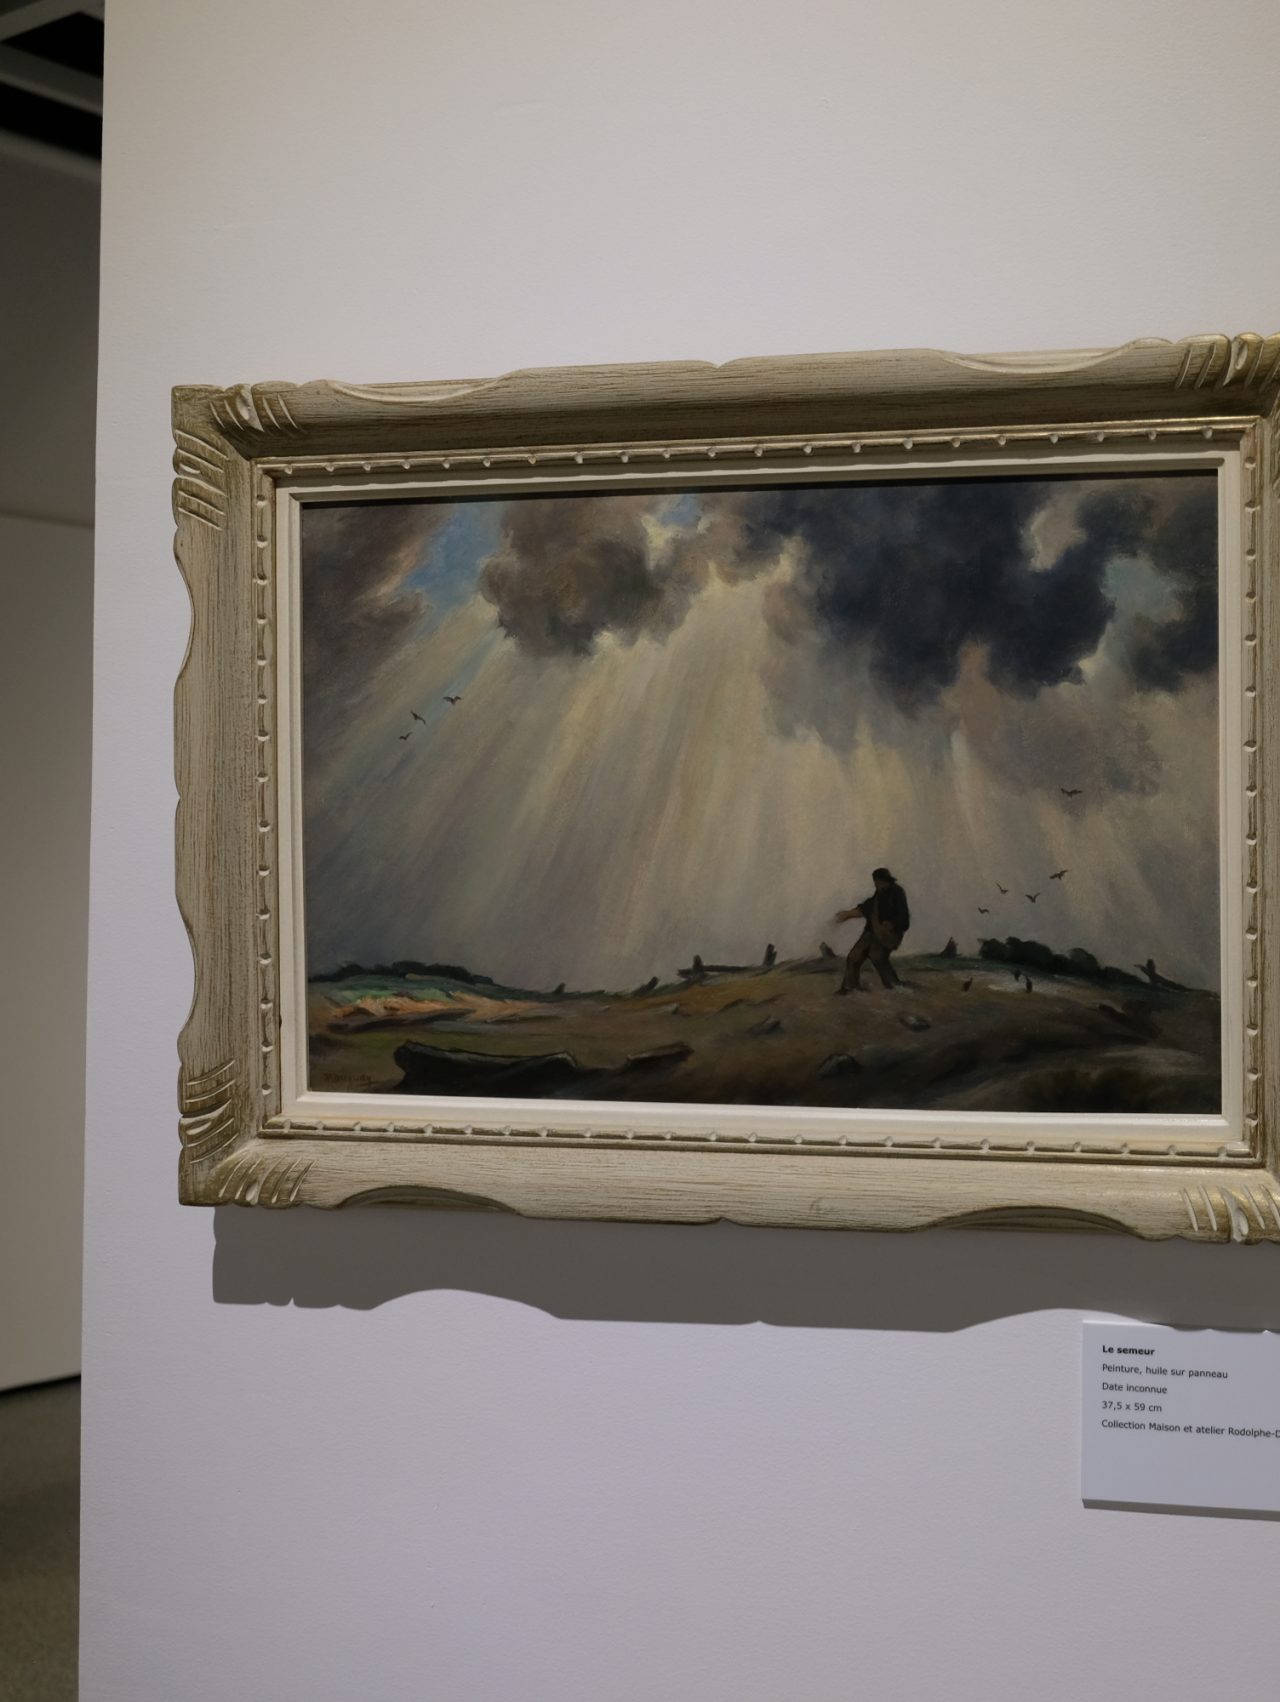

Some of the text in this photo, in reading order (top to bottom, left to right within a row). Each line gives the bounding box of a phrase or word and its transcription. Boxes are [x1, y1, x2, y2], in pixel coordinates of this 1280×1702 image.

[1102, 1344, 1156, 1357] Le semeur
[1102, 1362, 1229, 1380] Peinture, huile sur panneau
[1101, 1381, 1168, 1395] Date inconnue
[1101, 1400, 1163, 1413] 37,5 x 59 cm
[1101, 1418, 1146, 1431] Collection
[1148, 1421, 1181, 1433] Maison
[1183, 1424, 1194, 1434] et
[1195, 1425, 1226, 1437] atelier
